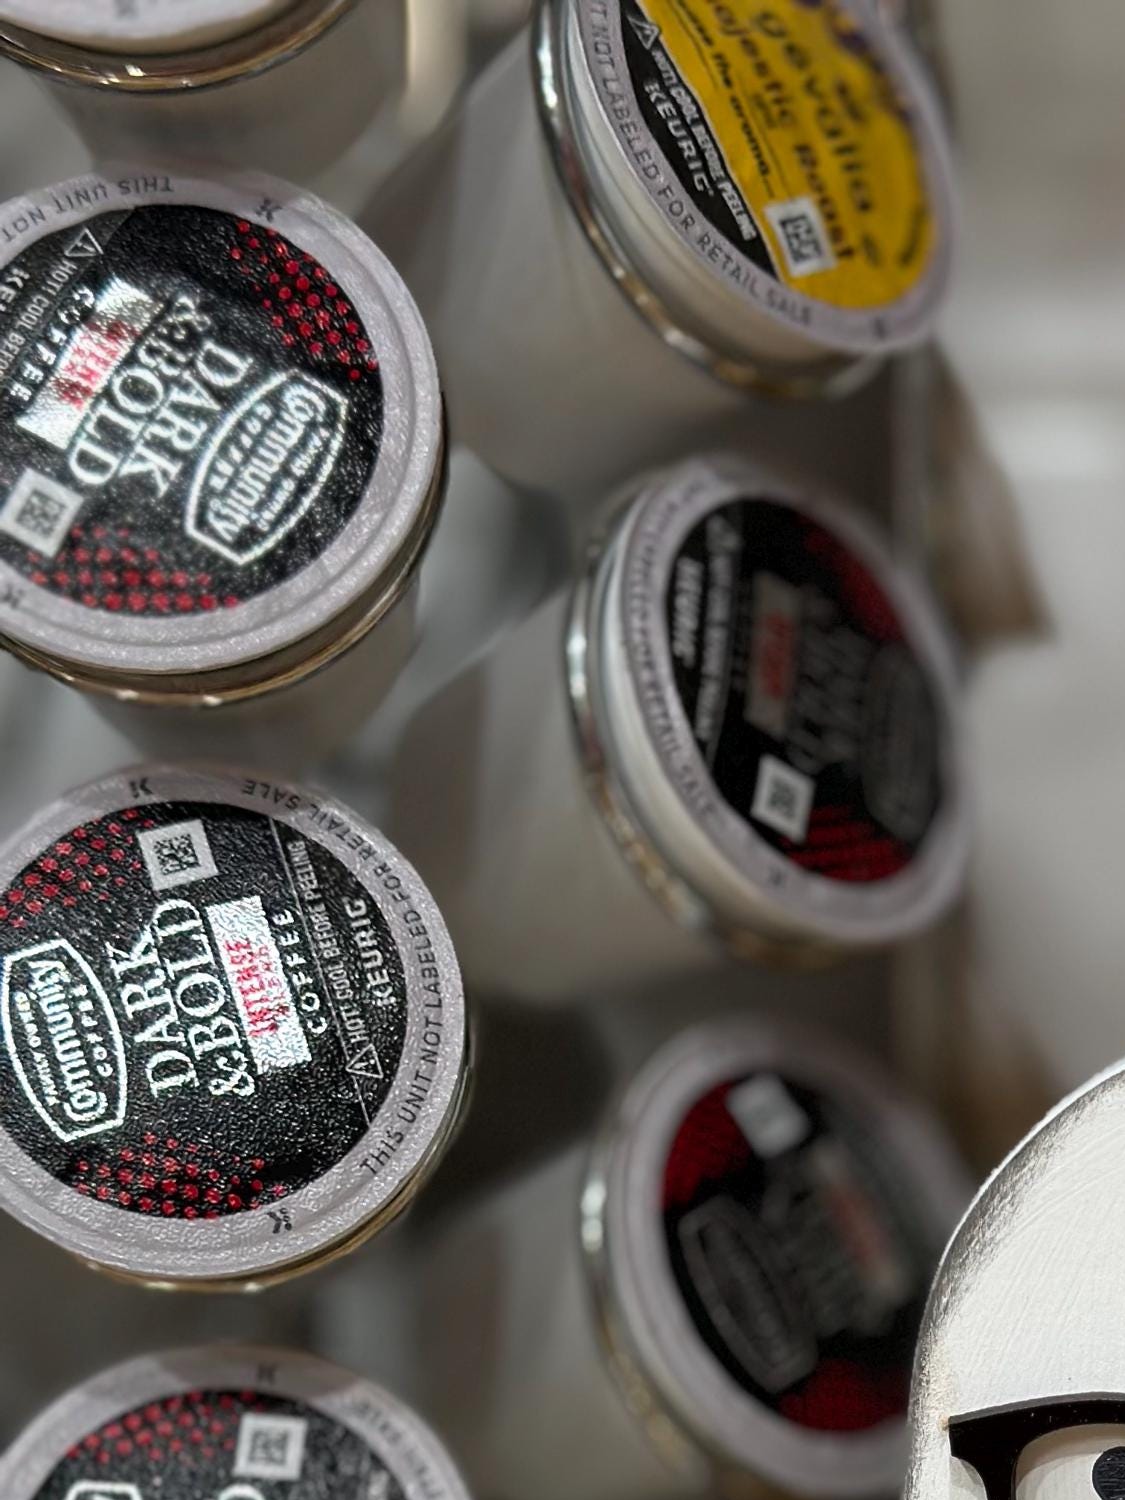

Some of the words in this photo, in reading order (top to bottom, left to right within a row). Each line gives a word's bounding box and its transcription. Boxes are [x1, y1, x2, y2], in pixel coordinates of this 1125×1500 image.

[644, 79, 710, 193] KEURIG
[51, 184, 107, 214] UNIT
[119, 176, 175, 195] THIS
[602, 76, 661, 180] LABELED
[658, 185, 696, 231] FOR
[696, 233, 761, 298] RETAIL
[1, 206, 47, 244] NOT
[15, 294, 50, 330] COOL
[118, 340, 254, 498] DARK
[205, 382, 328, 542] Community
[242, 779, 301, 811] SALE
[307, 803, 379, 862] RETAIL
[286, 839, 322, 901] PEELING
[372, 861, 412, 904] FOR
[308, 902, 341, 958] BEFORE
[344, 896, 398, 1007] KEURIG
[272, 908, 329, 1035] COFFEE
[327, 958, 355, 1000] COOL
[402, 909, 443, 1009] LABELED
[105, 924, 200, 1098] DARK
[28, 960, 109, 1122] Community
[418, 1016, 444, 1065] NOT
[397, 1069, 432, 1124] UNIT
[358, 1126, 404, 1176] THIS
